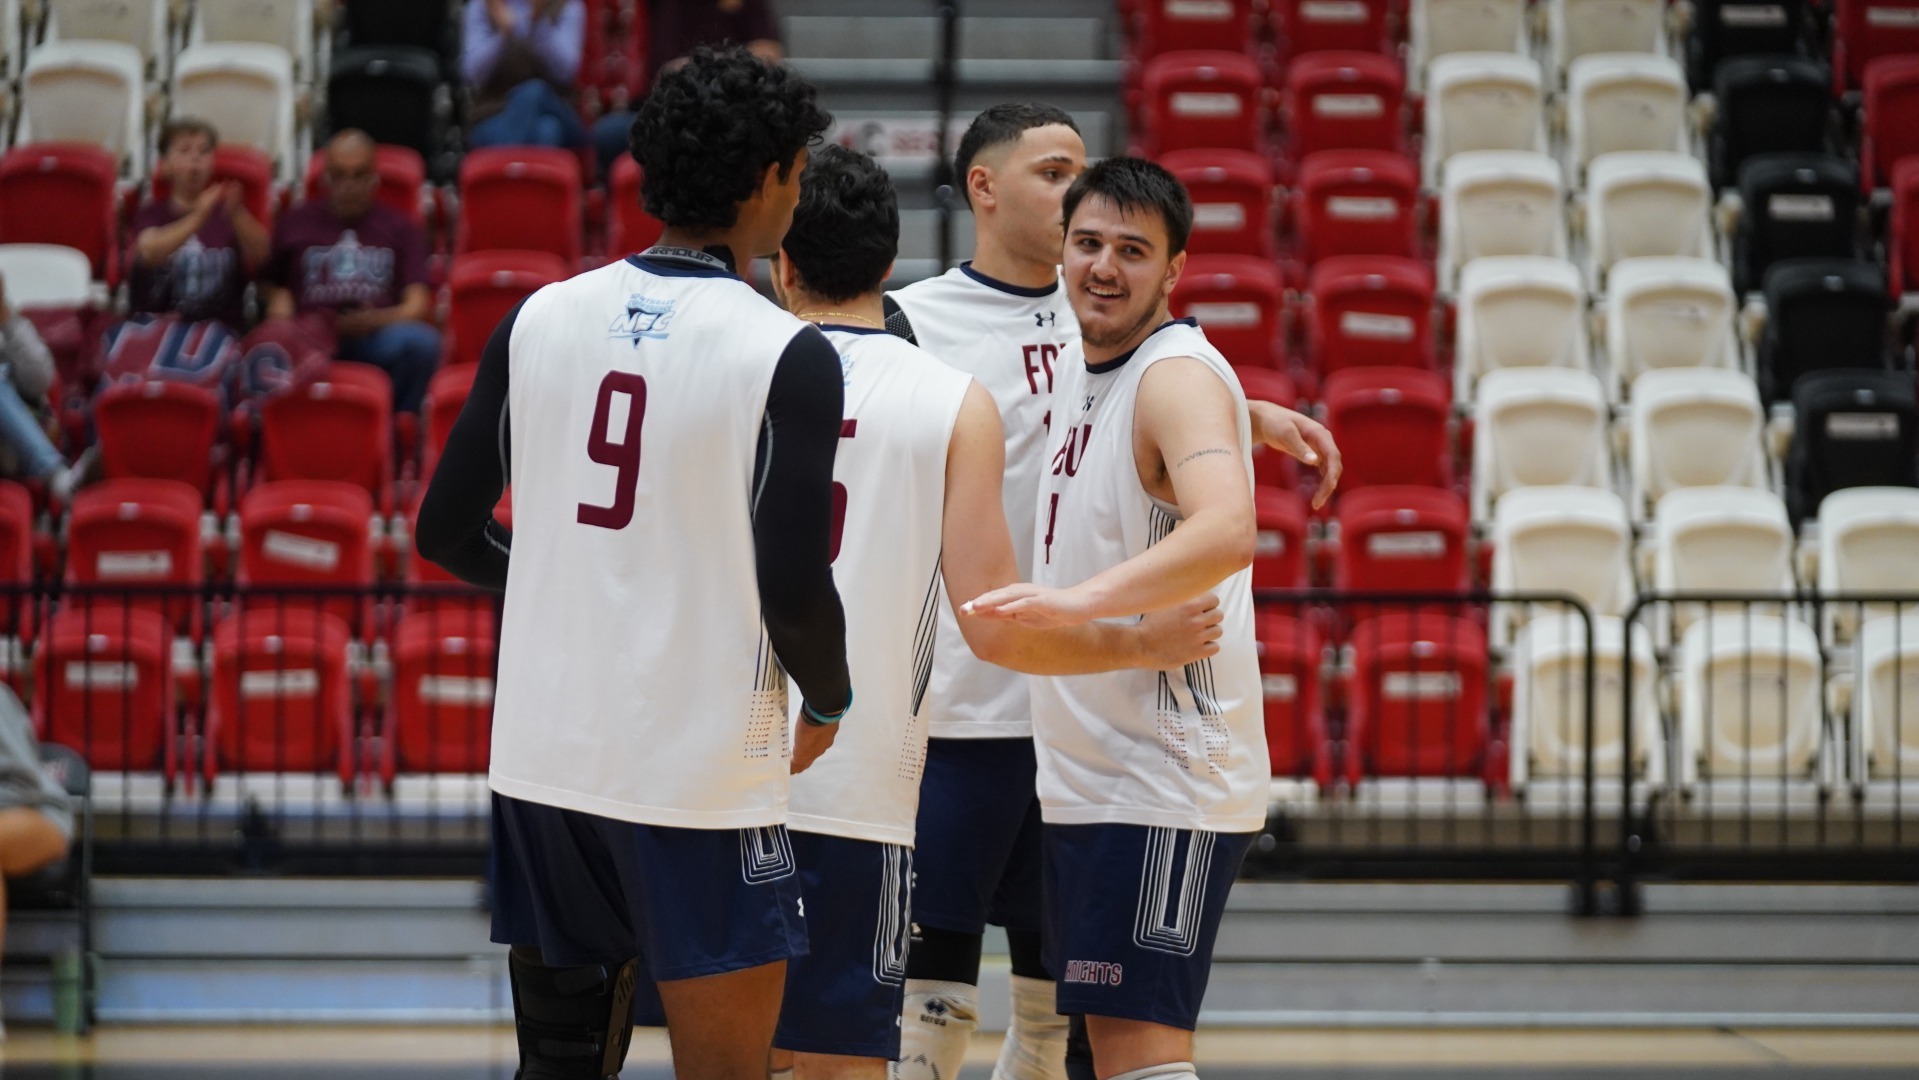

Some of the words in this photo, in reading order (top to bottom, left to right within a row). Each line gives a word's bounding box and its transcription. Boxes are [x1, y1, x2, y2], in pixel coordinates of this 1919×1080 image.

[608, 311, 677, 334] NEC
[1022, 343, 1067, 395] FD
[577, 369, 647, 530] 9
[1064, 960, 1122, 986] KNIGHTS
